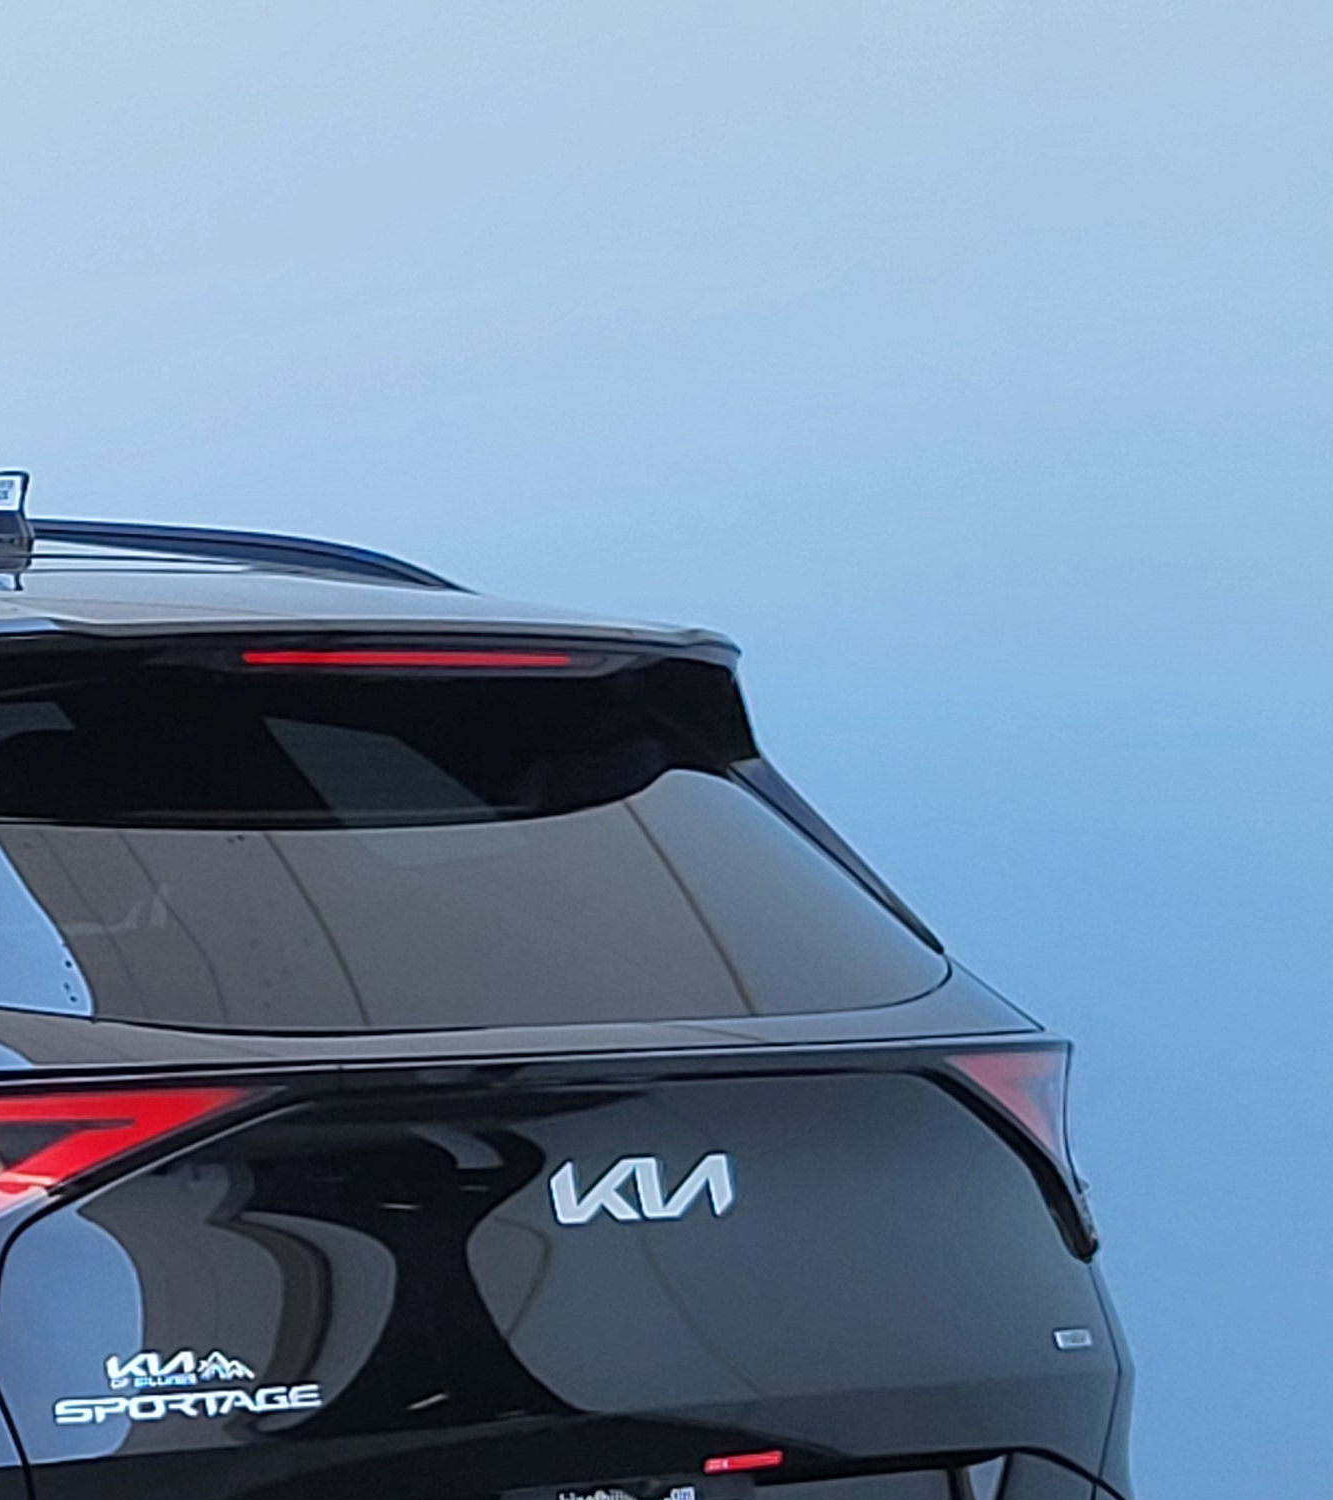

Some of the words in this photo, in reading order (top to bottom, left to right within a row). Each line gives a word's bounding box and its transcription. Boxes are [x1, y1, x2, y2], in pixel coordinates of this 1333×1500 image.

[550, 1153, 732, 1224] KIA
[105, 1351, 196, 1379] KIA
[54, 1384, 323, 1425] SPORTAGE
